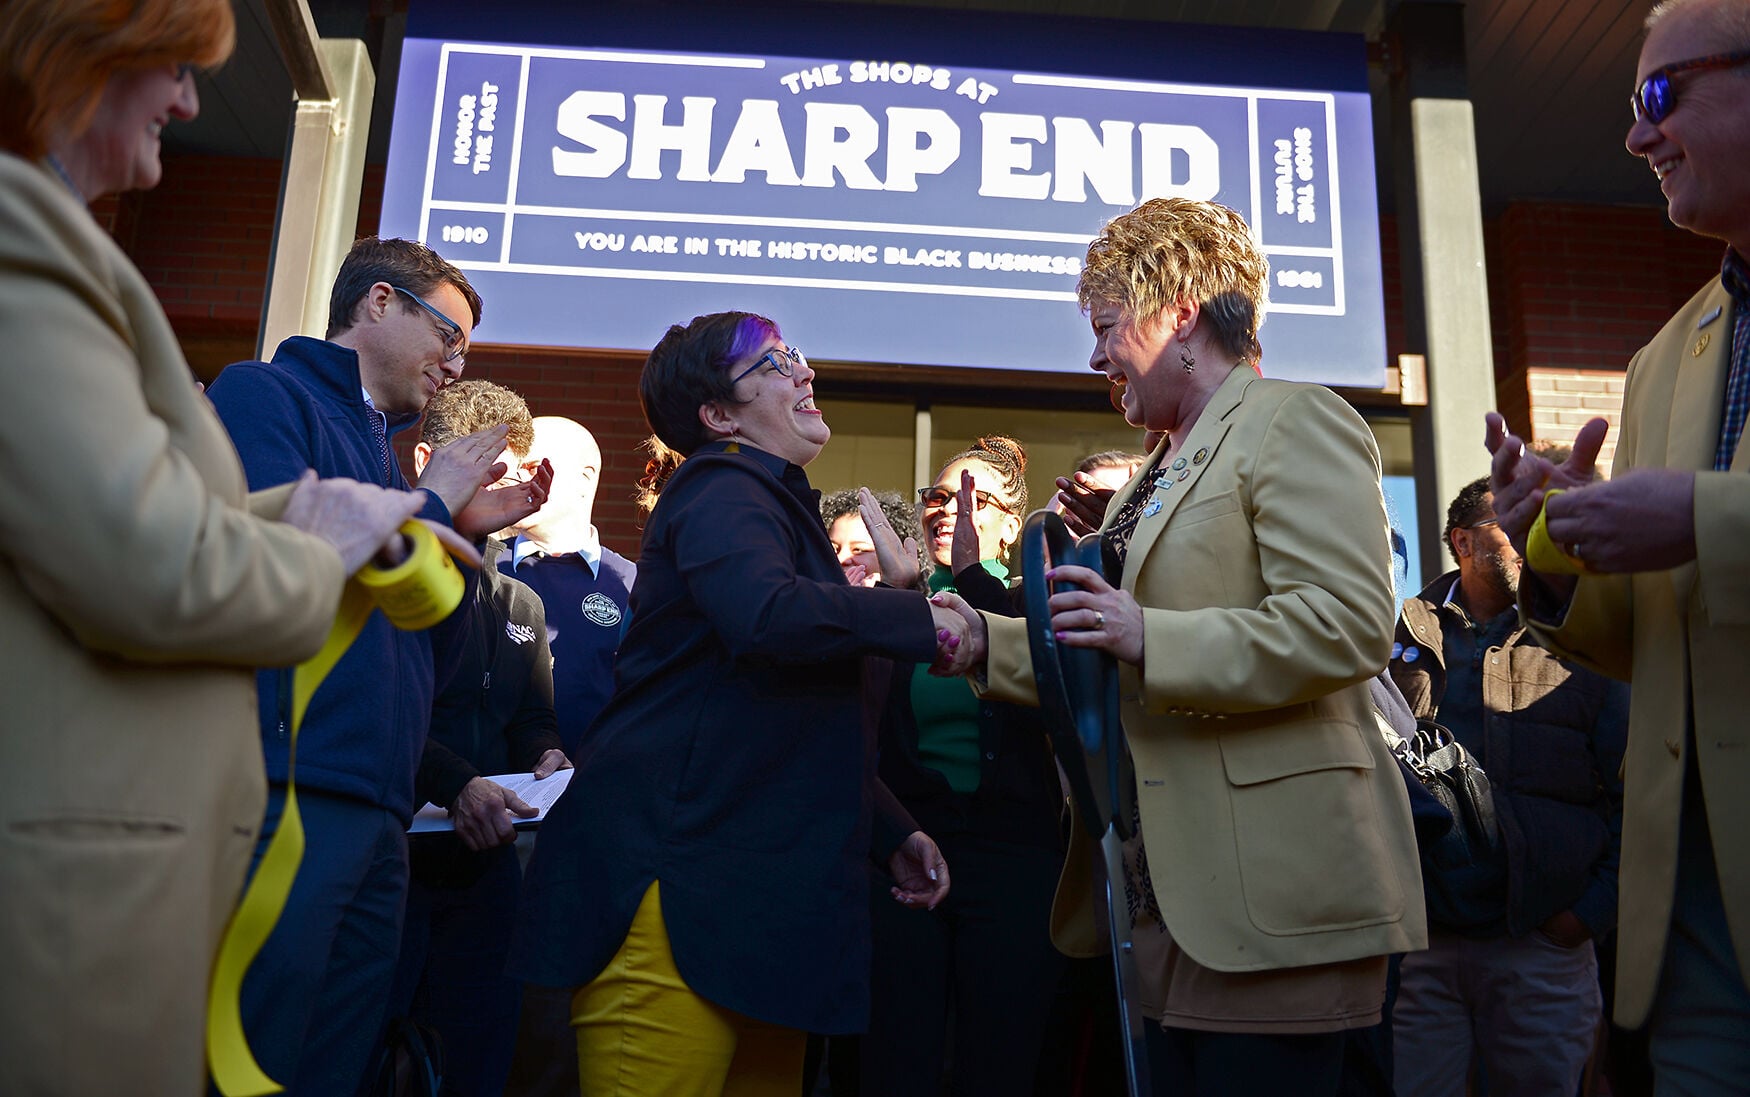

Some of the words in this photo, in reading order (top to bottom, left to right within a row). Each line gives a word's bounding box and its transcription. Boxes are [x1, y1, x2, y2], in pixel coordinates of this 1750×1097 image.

[478, 81, 499, 131] PAST
[780, 63, 843, 95] THE
[849, 61, 951, 91] SHOPS
[955, 77, 999, 105] AT
[453, 94, 477, 165] HONOR
[552, 90, 961, 192] SHARP
[978, 112, 1220, 206] END
[473, 134, 494, 175] THE
[1274, 139, 1295, 215] FUTURE
[1293, 127, 1313, 182] SHOP
[1296, 183, 1316, 224] THE
[442, 225, 489, 244] 1910
[574, 231, 625, 252] YOU
[630, 235, 678, 254] ARE
[684, 237, 709, 255] IN
[714, 238, 762, 258] THE
[767, 240, 878, 264] HISTORIC
[883, 246, 962, 268] BLACK
[968, 251, 1082, 276] BUSINESS
